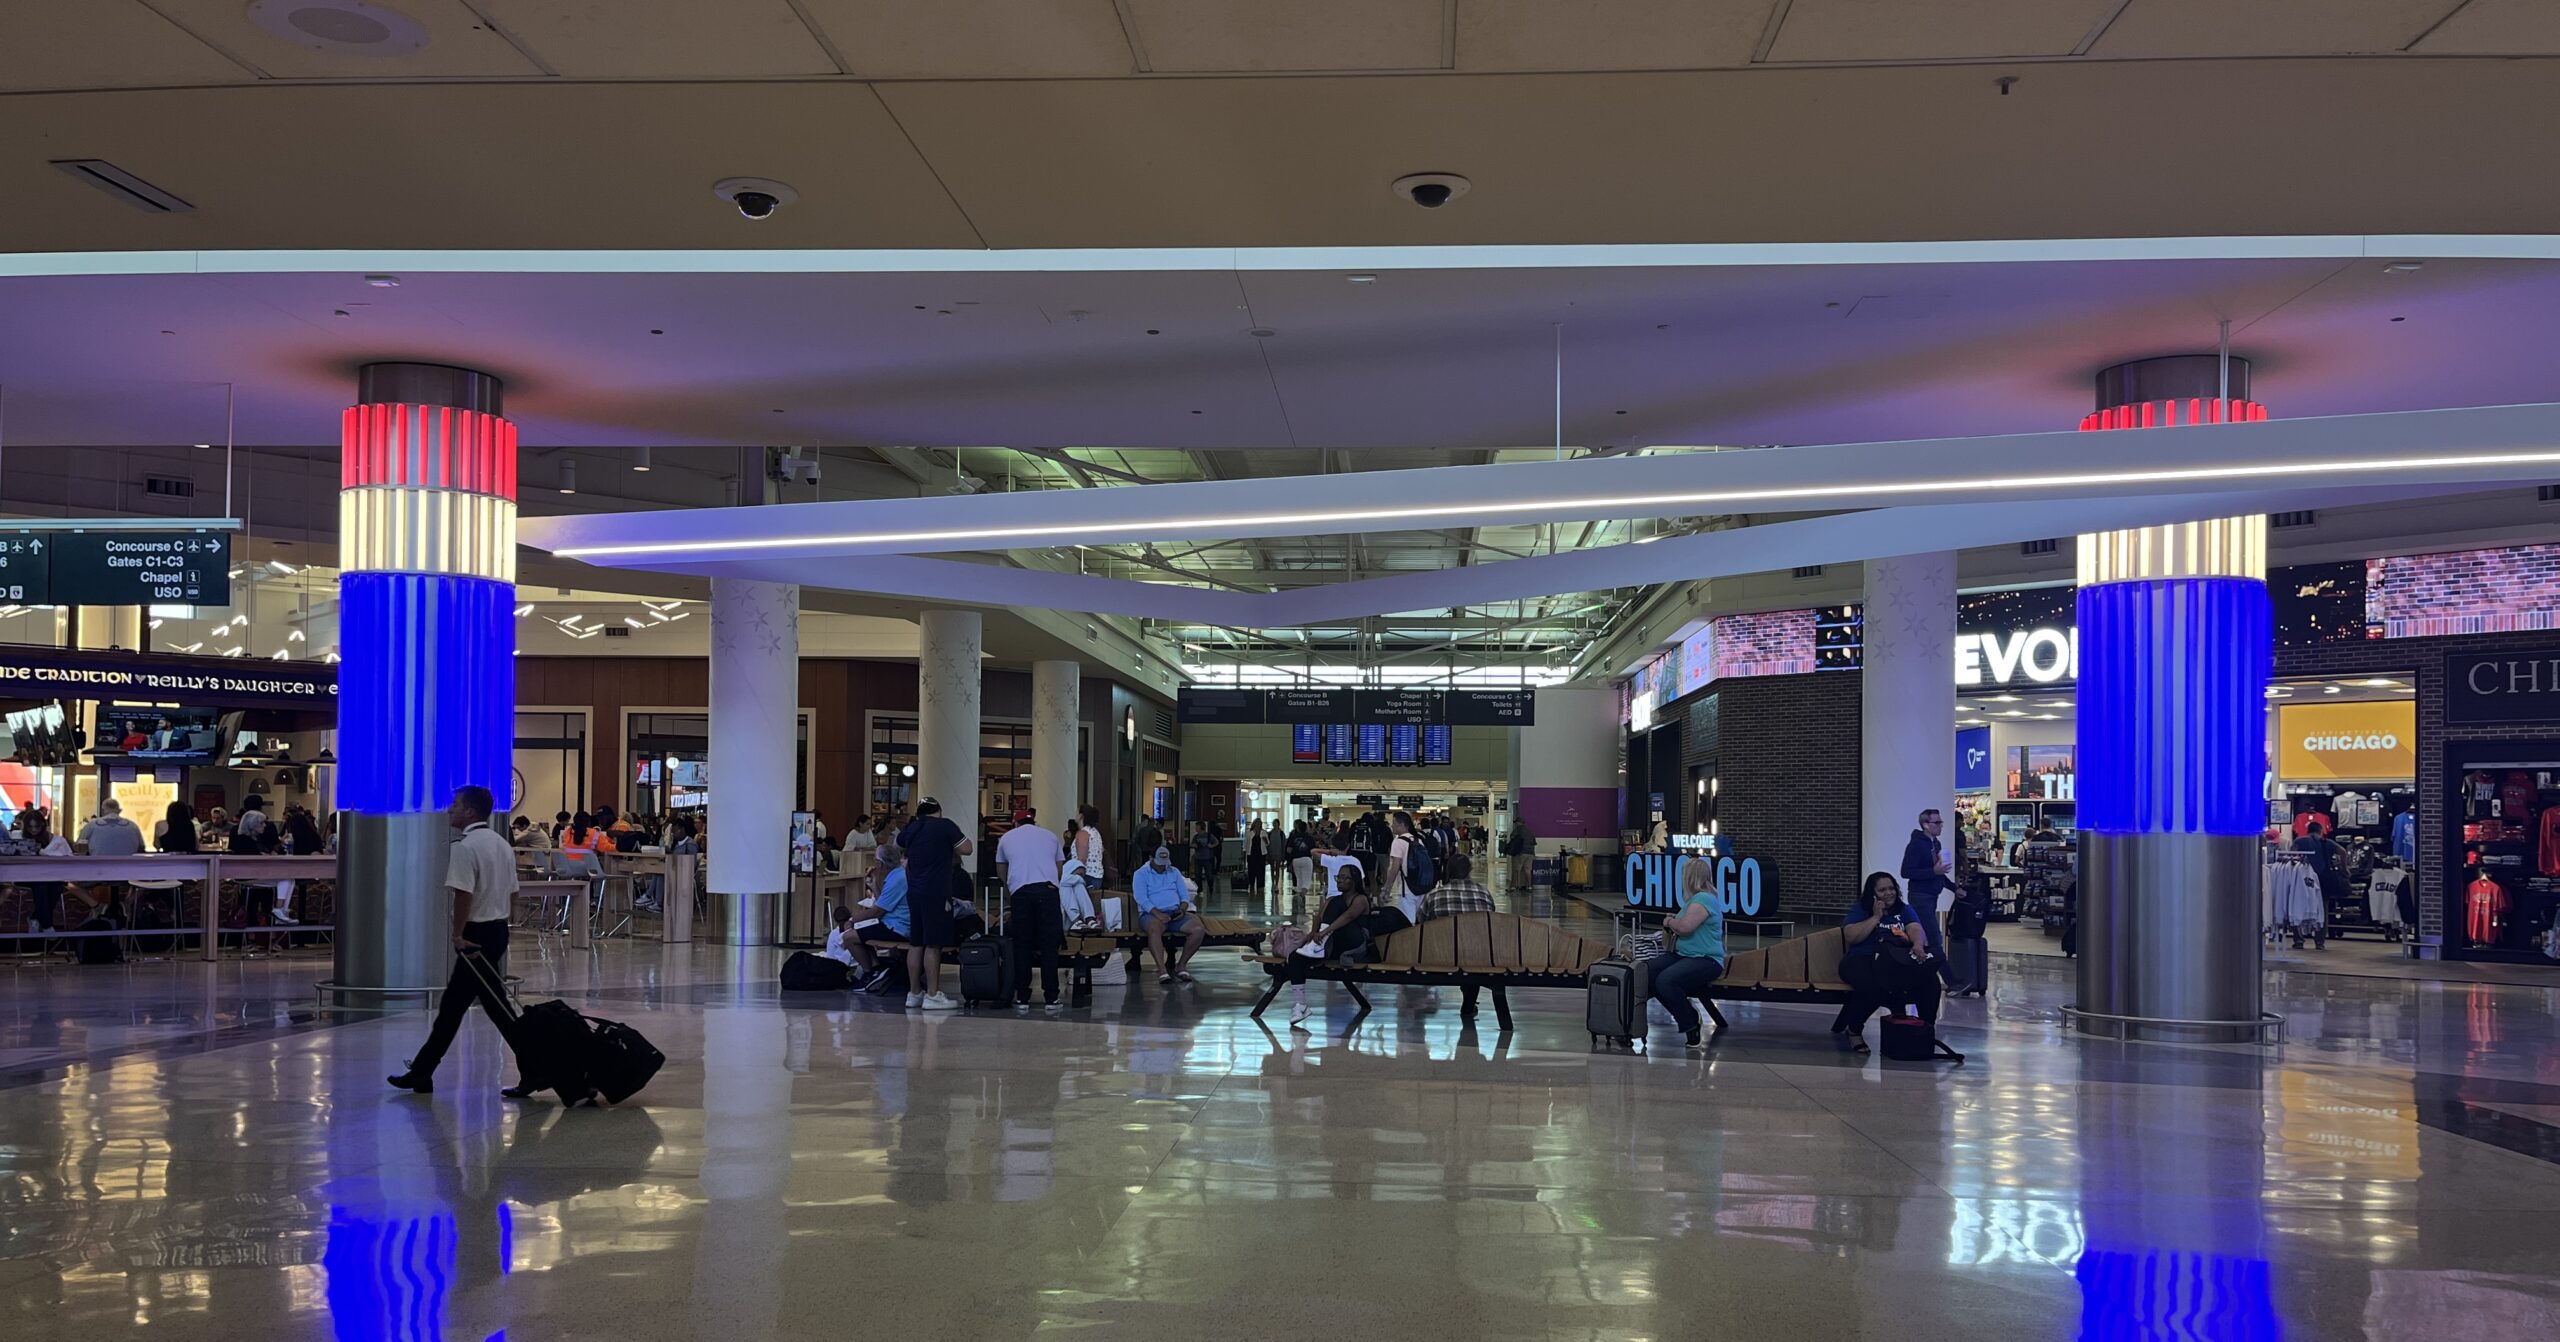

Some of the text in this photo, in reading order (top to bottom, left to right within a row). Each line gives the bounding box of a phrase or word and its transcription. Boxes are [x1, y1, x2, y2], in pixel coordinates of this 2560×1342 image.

[106, 541, 184, 552] Concourse C
[107, 556, 184, 567] Gates C1-C3
[140, 572, 182, 584] Chapel
[154, 587, 182, 598] USO
[34, 668, 132, 684] TRADITION
[148, 674, 220, 690] REILLY'S
[223, 678, 315, 695] DAUGHTER
[2303, 735, 2397, 750] CHICAGO
[1672, 834, 1715, 848] WELCOME
[1626, 853, 1761, 916] CHICGO
